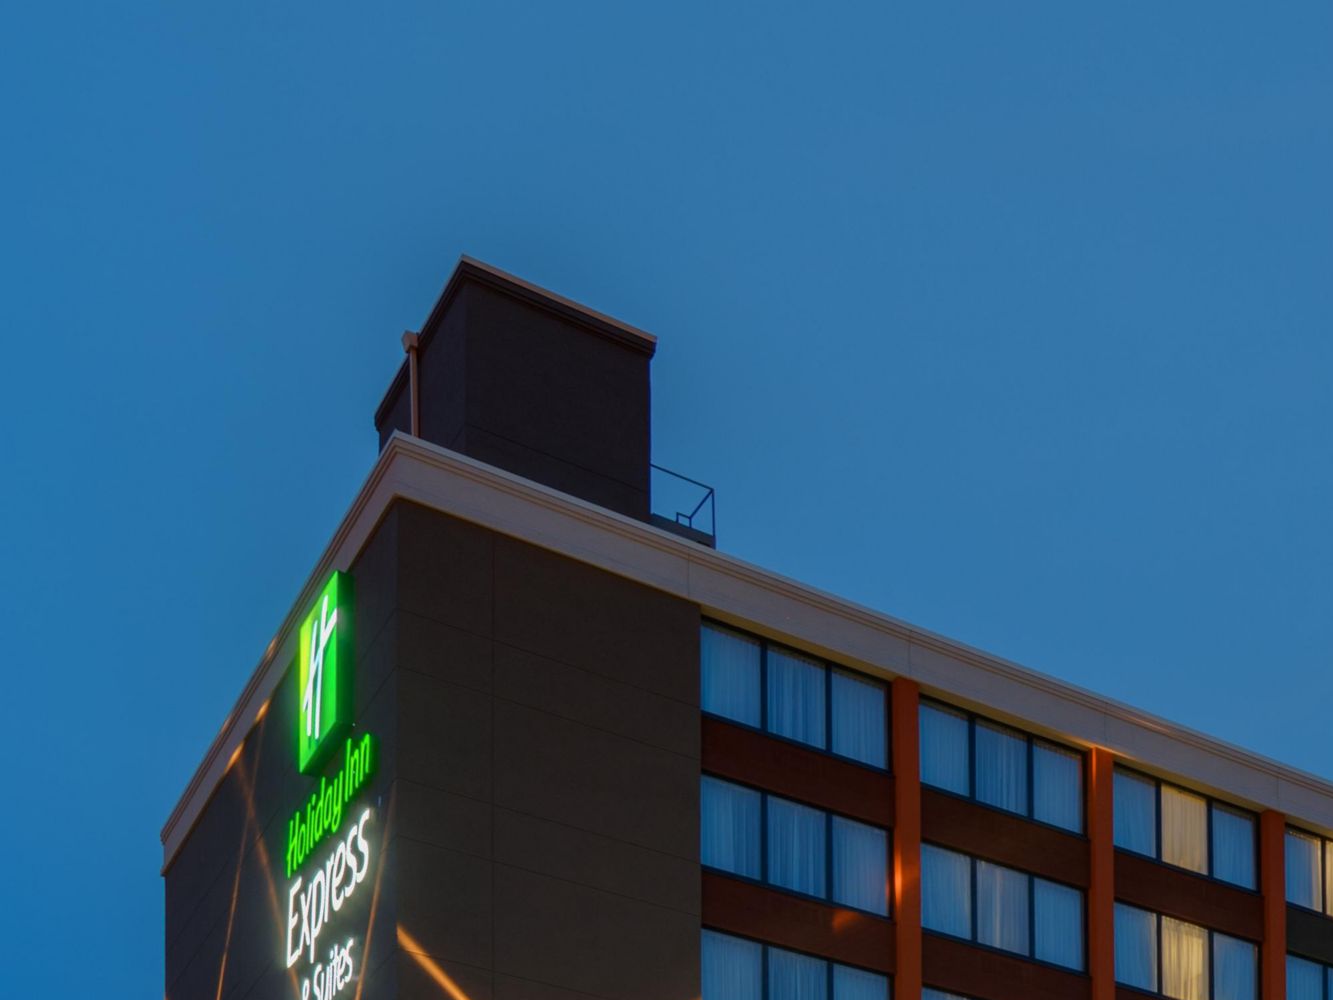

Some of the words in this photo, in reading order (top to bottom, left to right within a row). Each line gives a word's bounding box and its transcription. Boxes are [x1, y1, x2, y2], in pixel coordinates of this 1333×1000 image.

[287, 770, 344, 879] Holiday
[345, 733, 370, 802] Inn
[286, 808, 371, 968] Express
